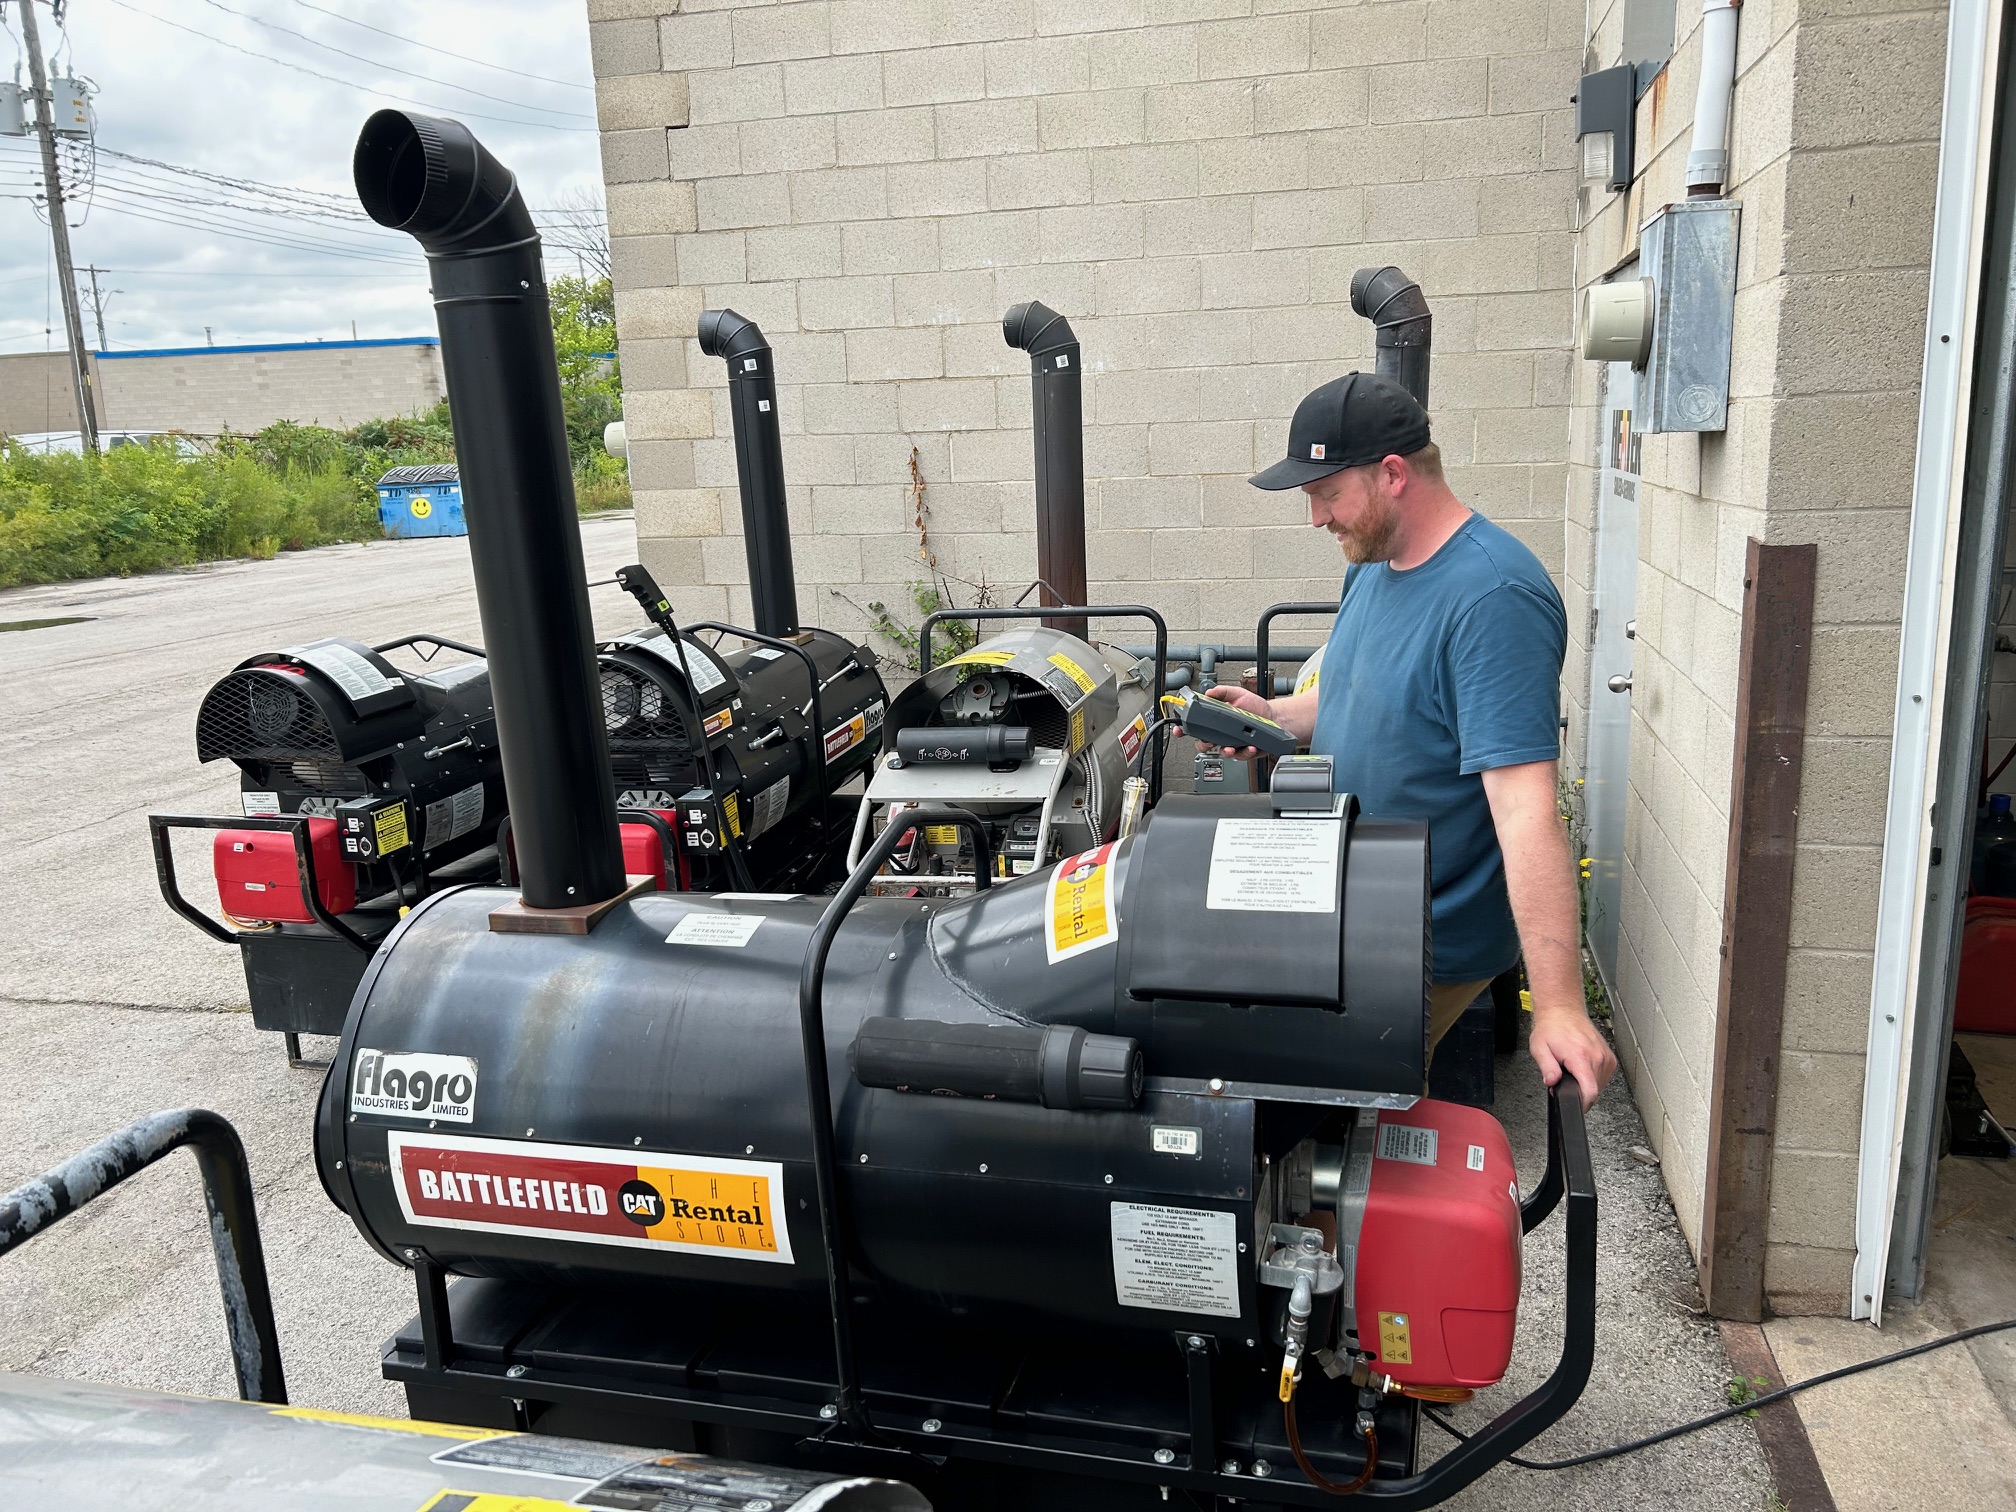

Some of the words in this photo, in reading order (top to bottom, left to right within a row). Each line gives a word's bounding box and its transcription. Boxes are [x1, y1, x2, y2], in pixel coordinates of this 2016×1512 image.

[1072, 882, 1089, 939] Rental
[356, 1055, 473, 1111] flagro
[354, 1096, 409, 1110] INDUSTRIES
[432, 1104, 469, 1116] LIMITED
[417, 1168, 609, 1216] BATTLEFIELD
[622, 1192, 656, 1216] CAT
[670, 1197, 764, 1226] Rental
[1129, 1205, 1165, 1213] ELECTRICAL
[1167, 1208, 1216, 1218] REQUIREMENTS:
[1175, 1262, 1214, 1271] CONDITIONS:
[1175, 1282, 1214, 1291] CONDITIONS:
